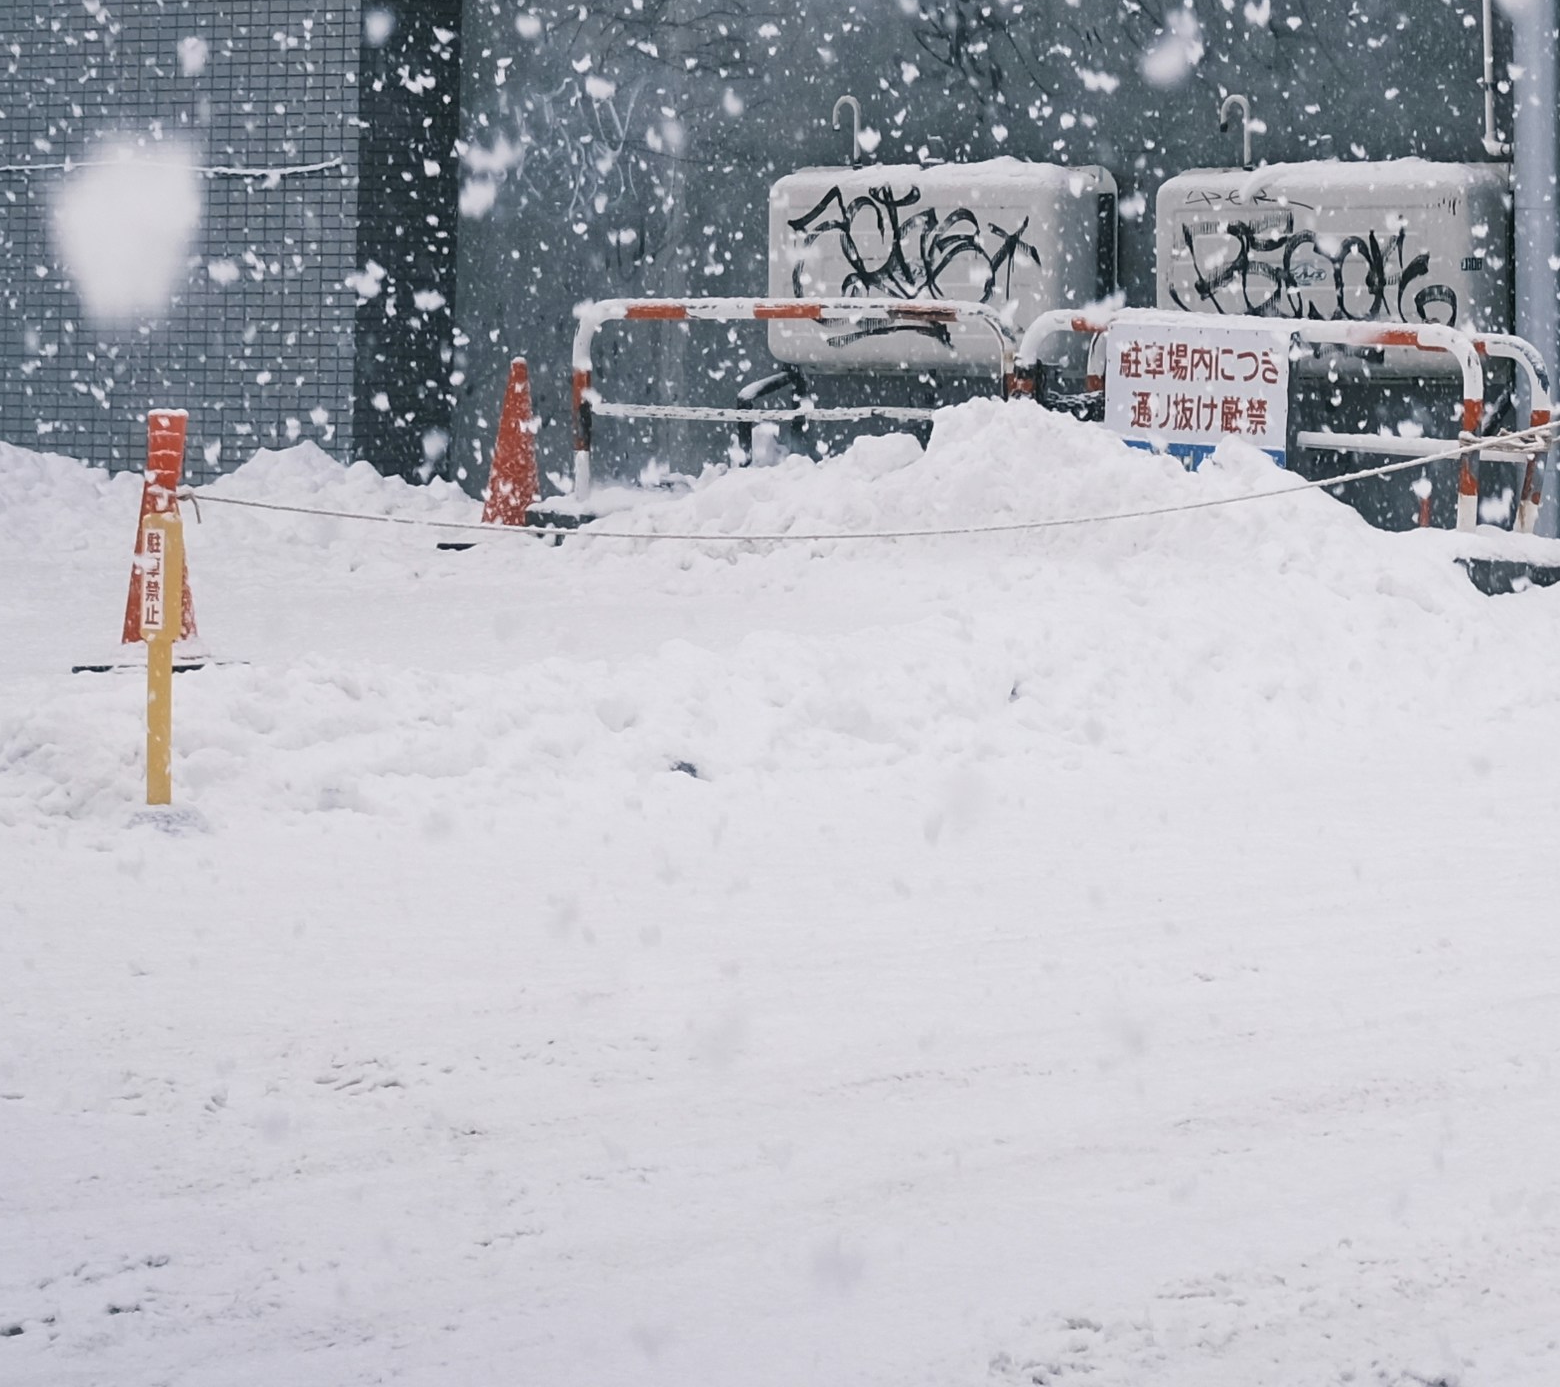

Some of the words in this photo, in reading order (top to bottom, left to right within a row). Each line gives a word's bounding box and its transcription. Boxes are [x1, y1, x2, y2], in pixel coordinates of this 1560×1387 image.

[1119, 340, 1279, 384] 駐車場内につき
[1130, 390, 1268, 435] 通り抜け厳禁
